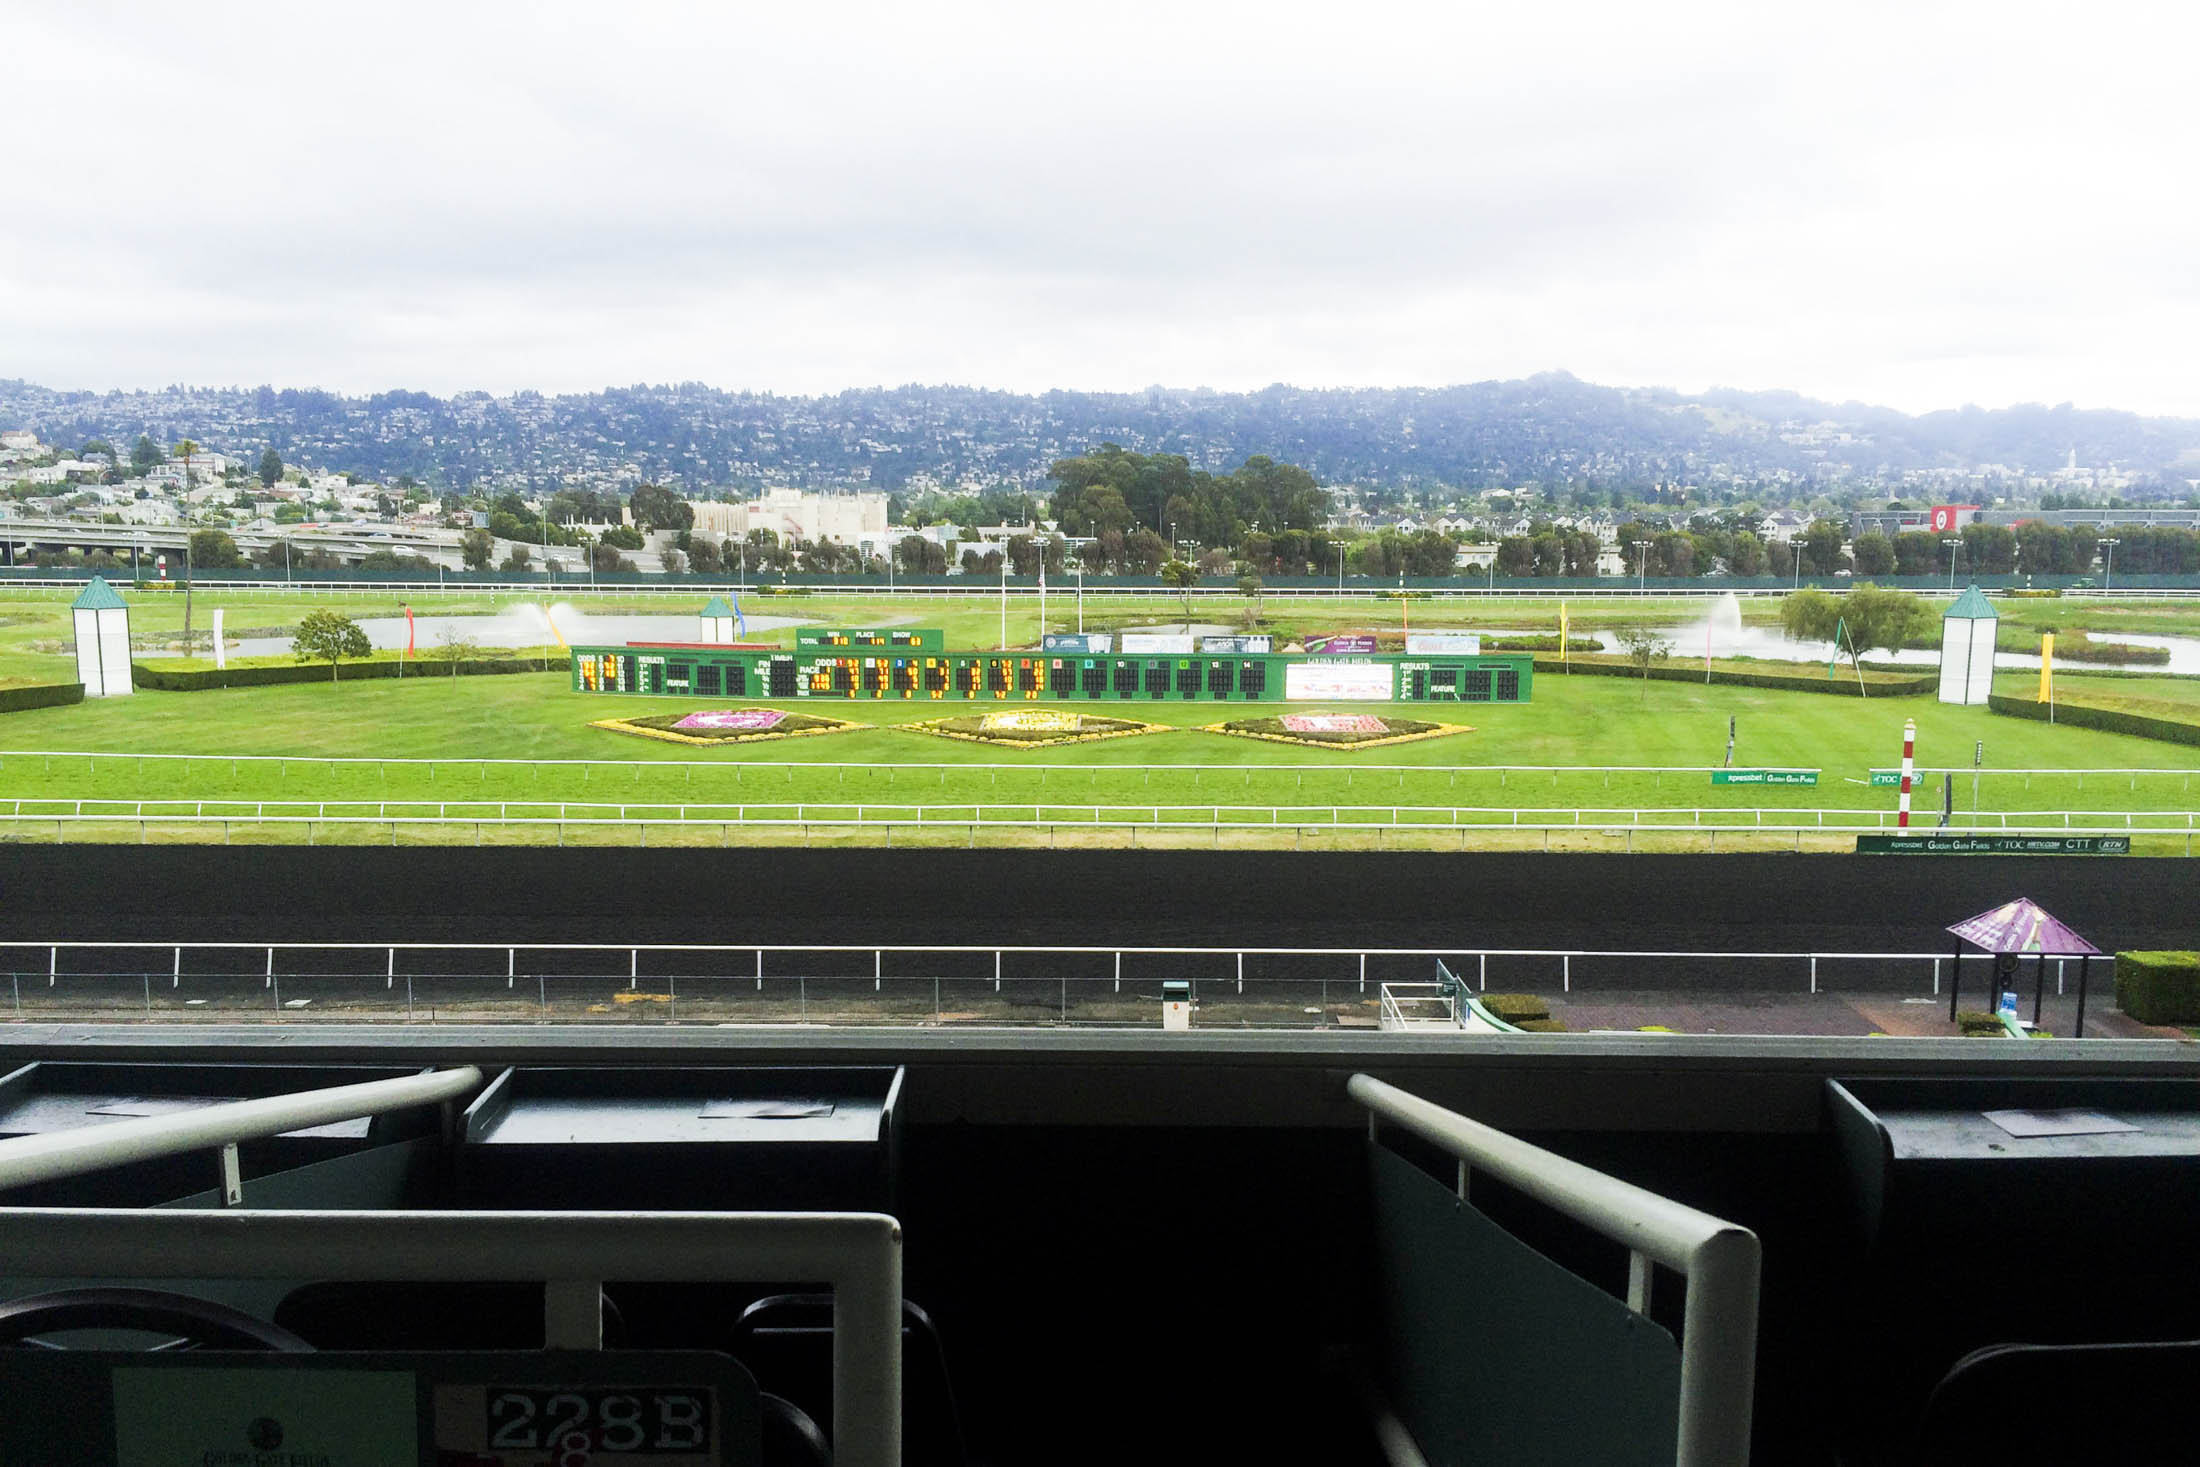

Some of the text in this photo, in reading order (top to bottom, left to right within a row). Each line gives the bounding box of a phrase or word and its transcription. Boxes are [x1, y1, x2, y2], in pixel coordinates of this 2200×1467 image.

[800, 637, 818, 645] TOTAL
[577, 654, 595, 662] ODDS
[638, 656, 664, 664] RESULTS
[815, 658, 837, 666] ODDS
[1307, 657, 1372, 665] GOLDEN GATE FIELDS
[799, 666, 820, 674] RACE
[1400, 662, 1430, 670] RESULTS
[1880, 775, 1897, 783] TOC
[1928, 840, 1952, 849] Golden
[1953, 840, 1970, 849] Gate
[1971, 840, 1990, 850] Fields
[2005, 840, 2025, 849] TOC
[2066, 839, 2091, 849] CTT
[492, 1393, 704, 1450] 228B
